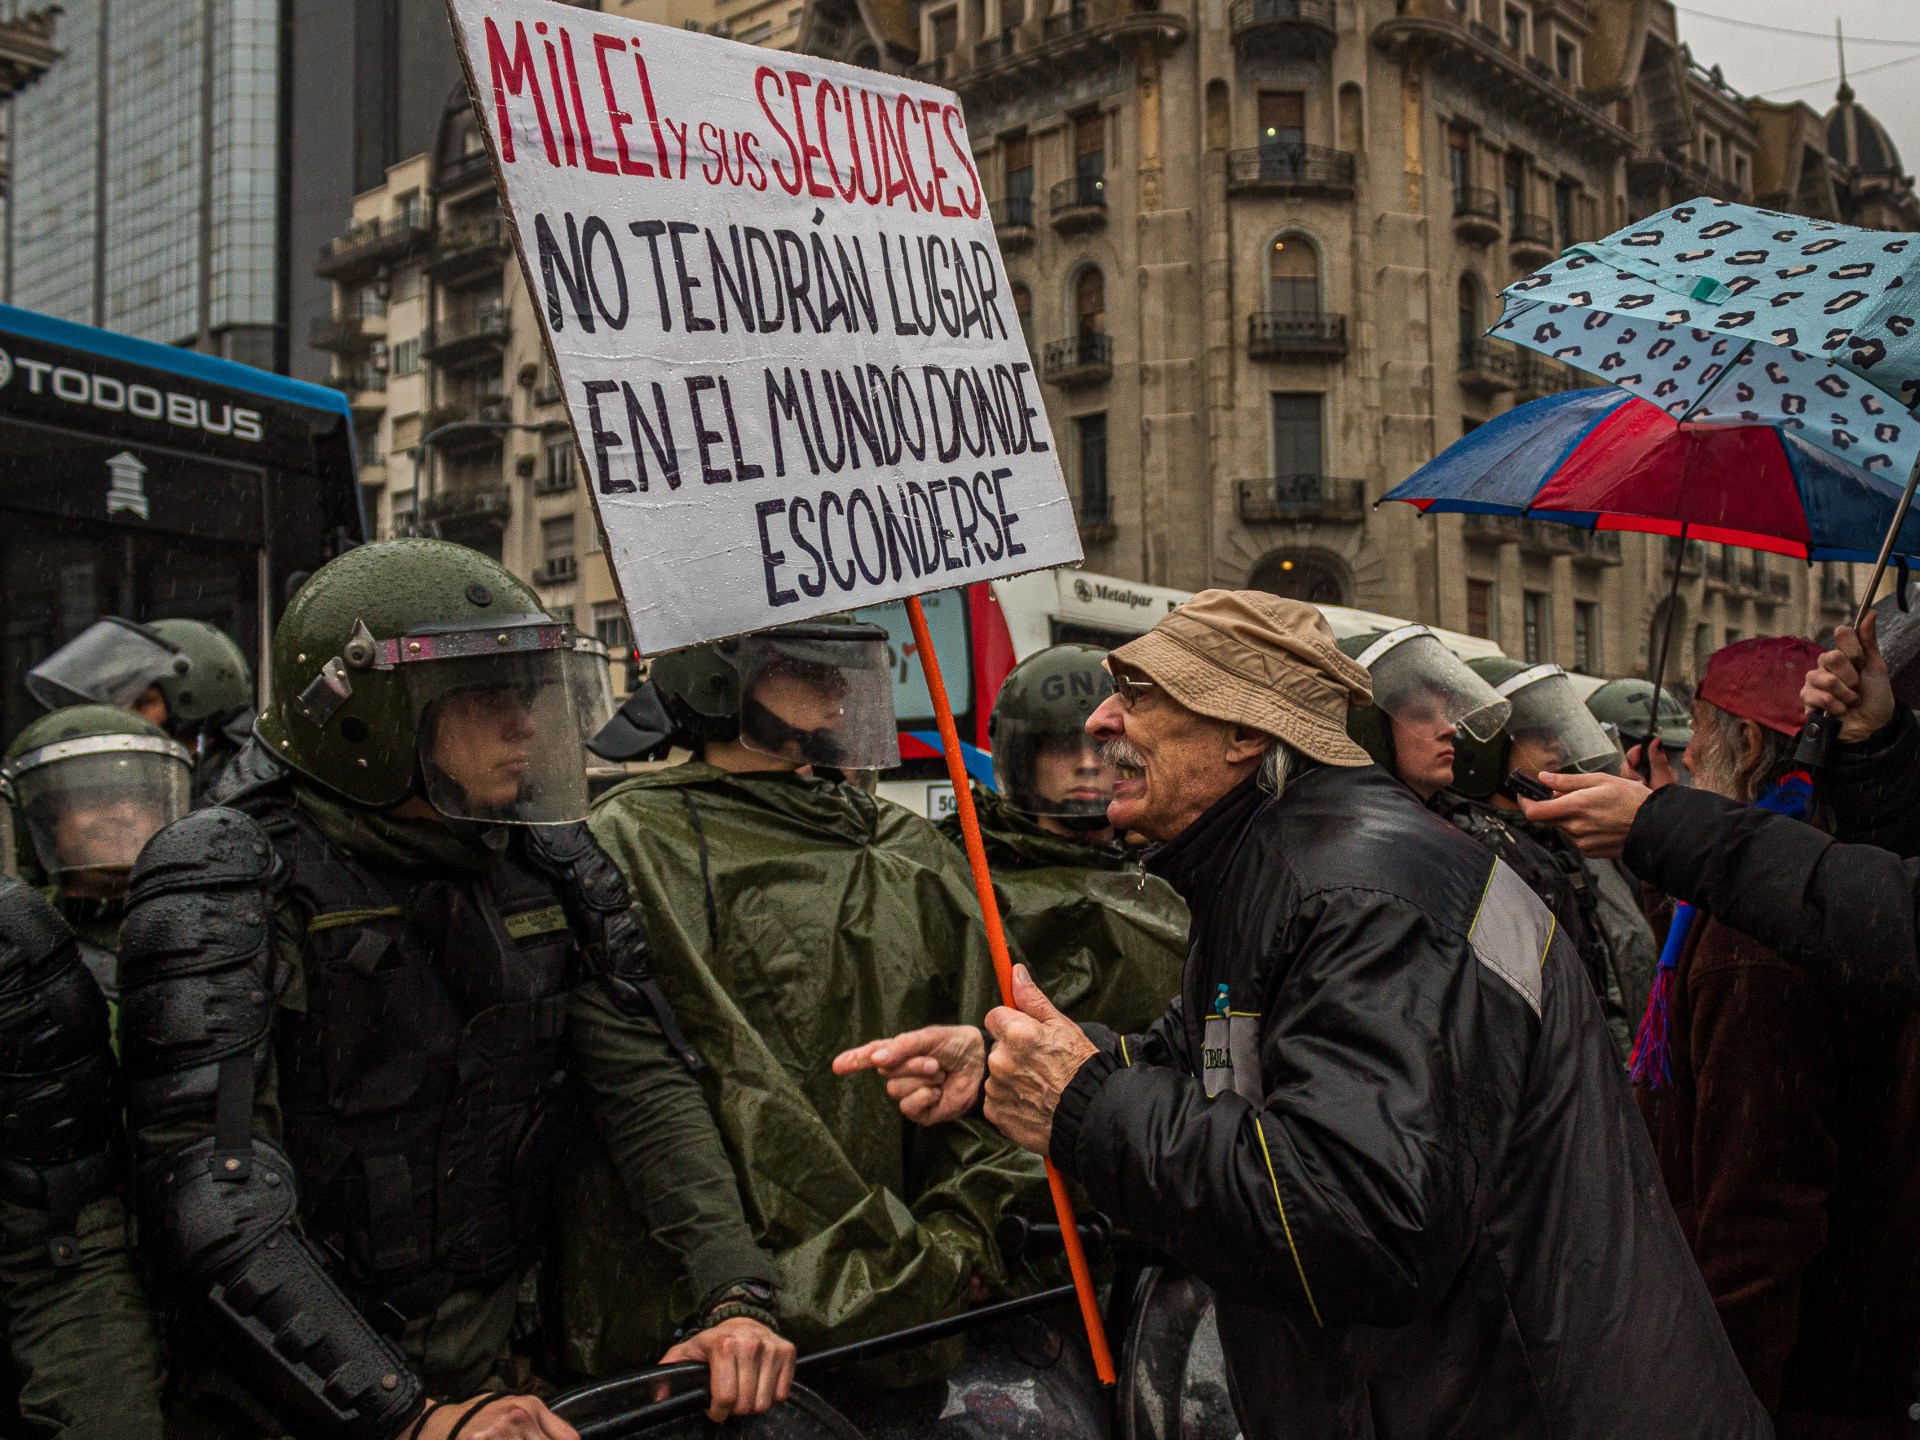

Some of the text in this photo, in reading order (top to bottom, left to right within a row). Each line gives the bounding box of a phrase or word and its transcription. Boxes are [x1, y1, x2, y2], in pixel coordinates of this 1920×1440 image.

[755, 66, 981, 219] SECUACES
[534, 207, 1008, 340] NO TENDRÁN LUGAR
[14, 356, 265, 442] TODOBUS
[582, 362, 1049, 495] EN EL MUNDO DONDE
[755, 467, 1026, 607] ESCONDERSE
[1095, 583, 1153, 609] Metalpar
